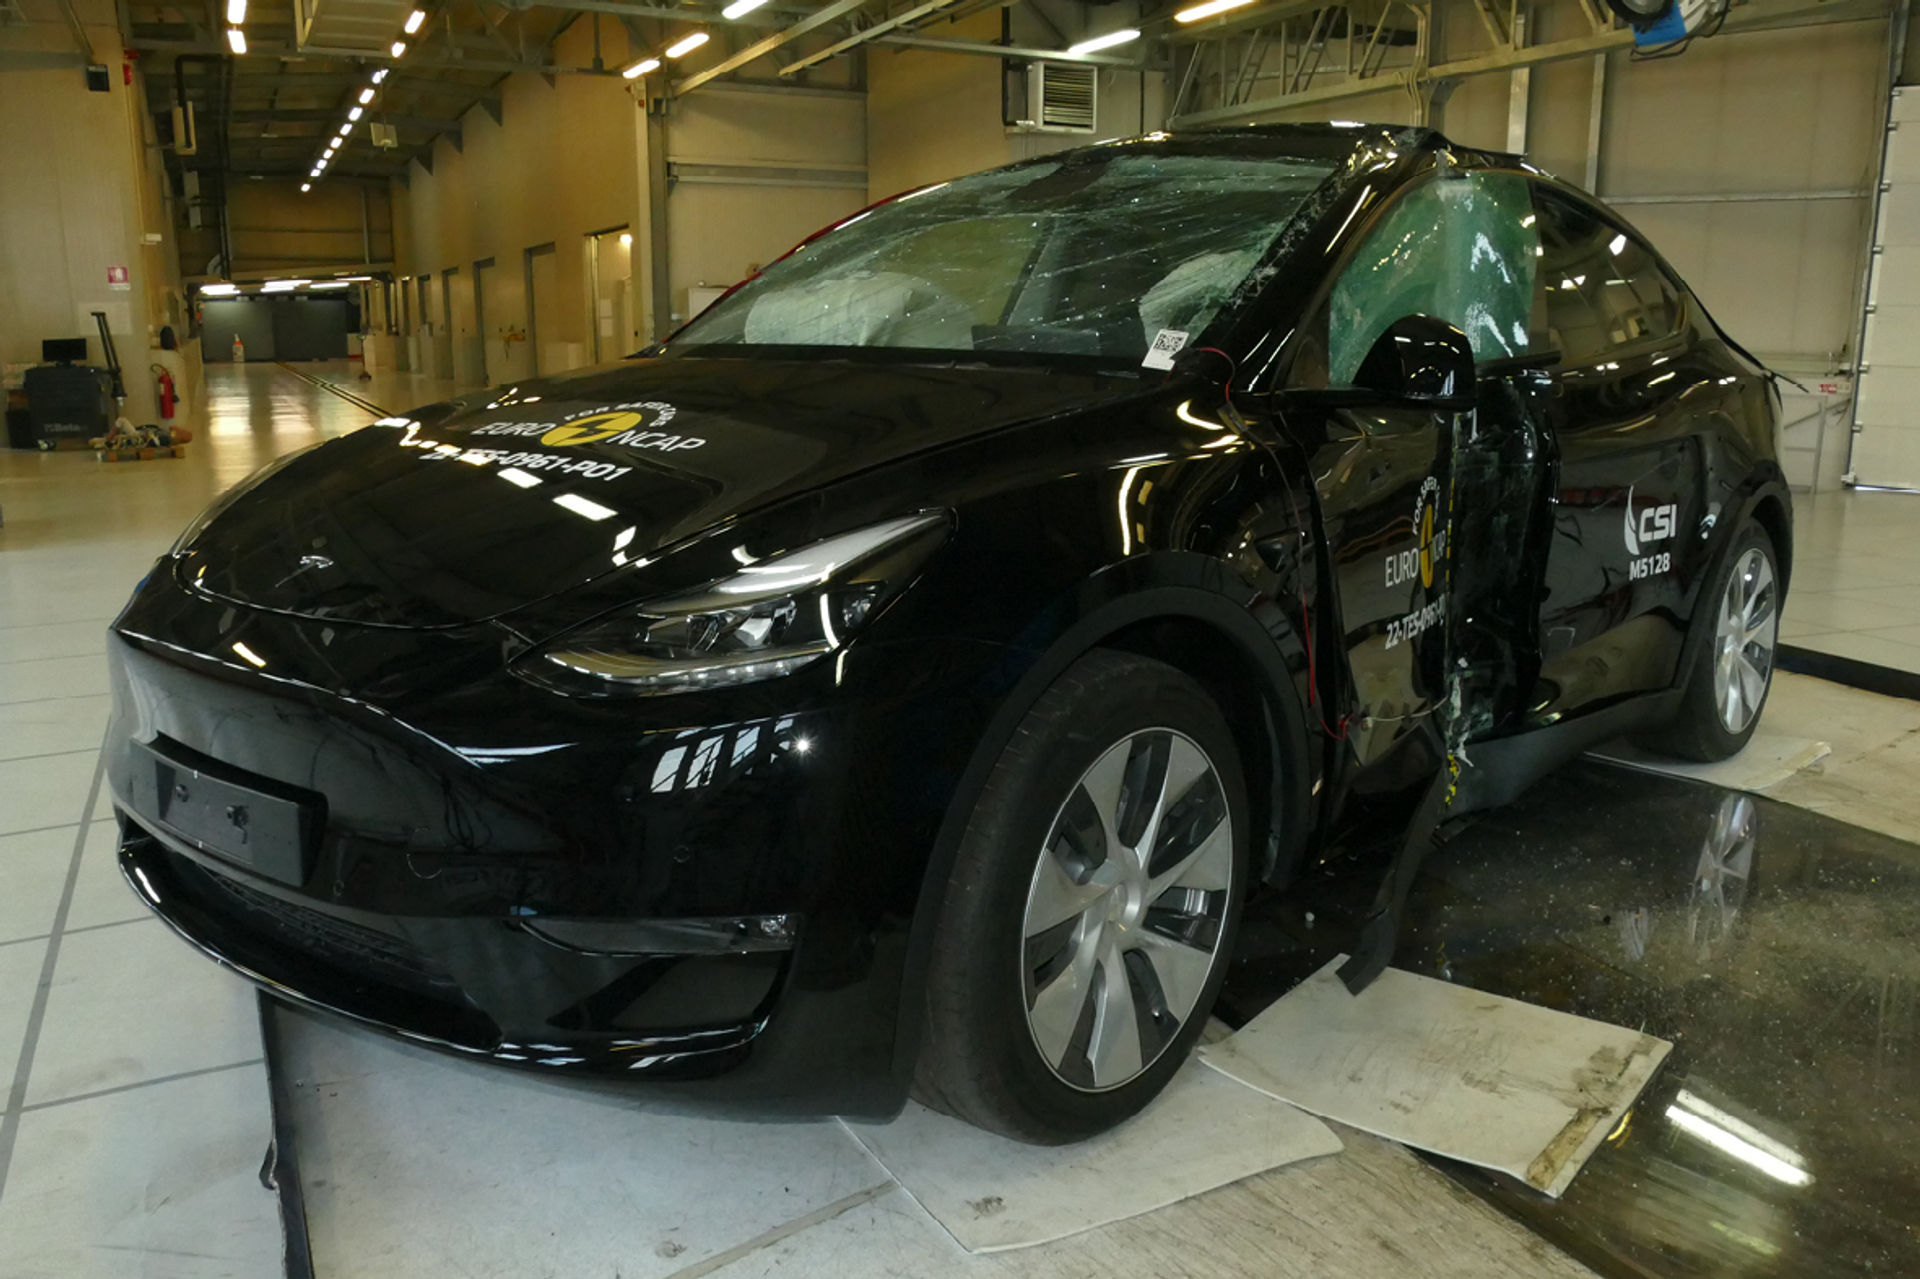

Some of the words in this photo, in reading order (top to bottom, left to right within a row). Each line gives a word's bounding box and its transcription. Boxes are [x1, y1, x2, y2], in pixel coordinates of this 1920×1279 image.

[564, 406, 610, 420] FOR
[471, 422, 556, 436] EURO
[605, 430, 706, 451] NCAP
[1639, 504, 1677, 543] CSI
[1385, 548, 1419, 588] EURO
[1628, 552, 1671, 581] M5128
